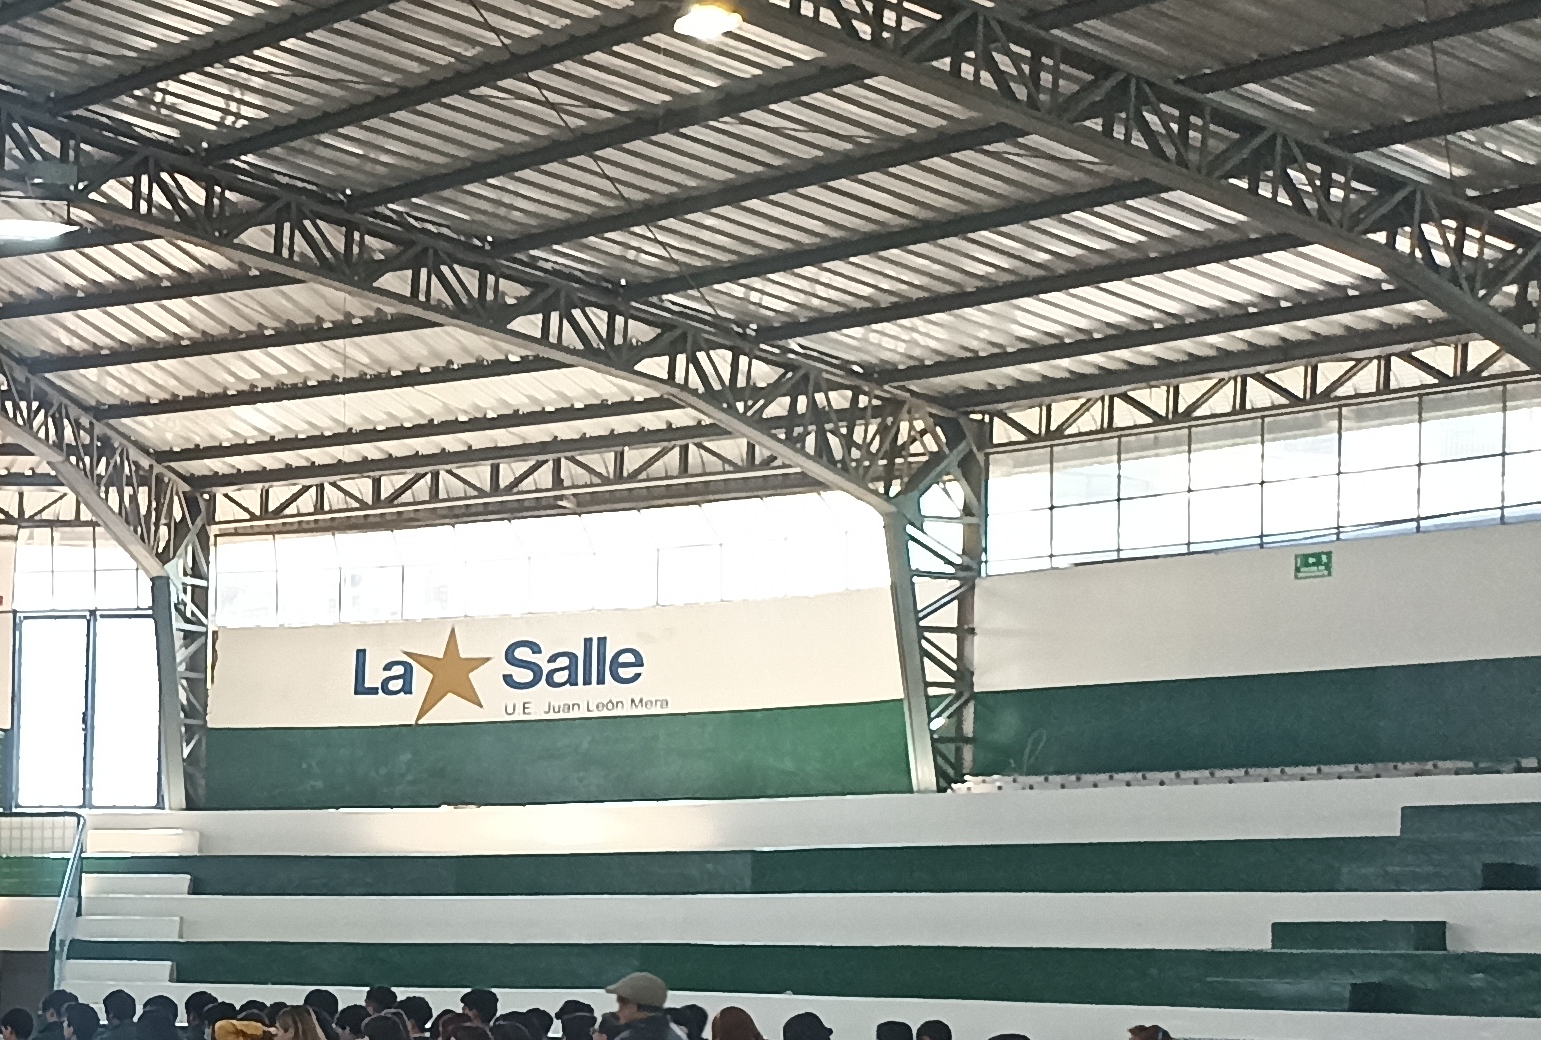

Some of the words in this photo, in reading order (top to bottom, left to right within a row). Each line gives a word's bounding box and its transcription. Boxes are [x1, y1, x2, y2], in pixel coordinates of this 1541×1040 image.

[354, 648, 413, 695] La
[502, 636, 645, 690] Salle
[543, 701, 581, 715] Juan
[586, 699, 624, 713] León
[630, 697, 670, 710] Mera
